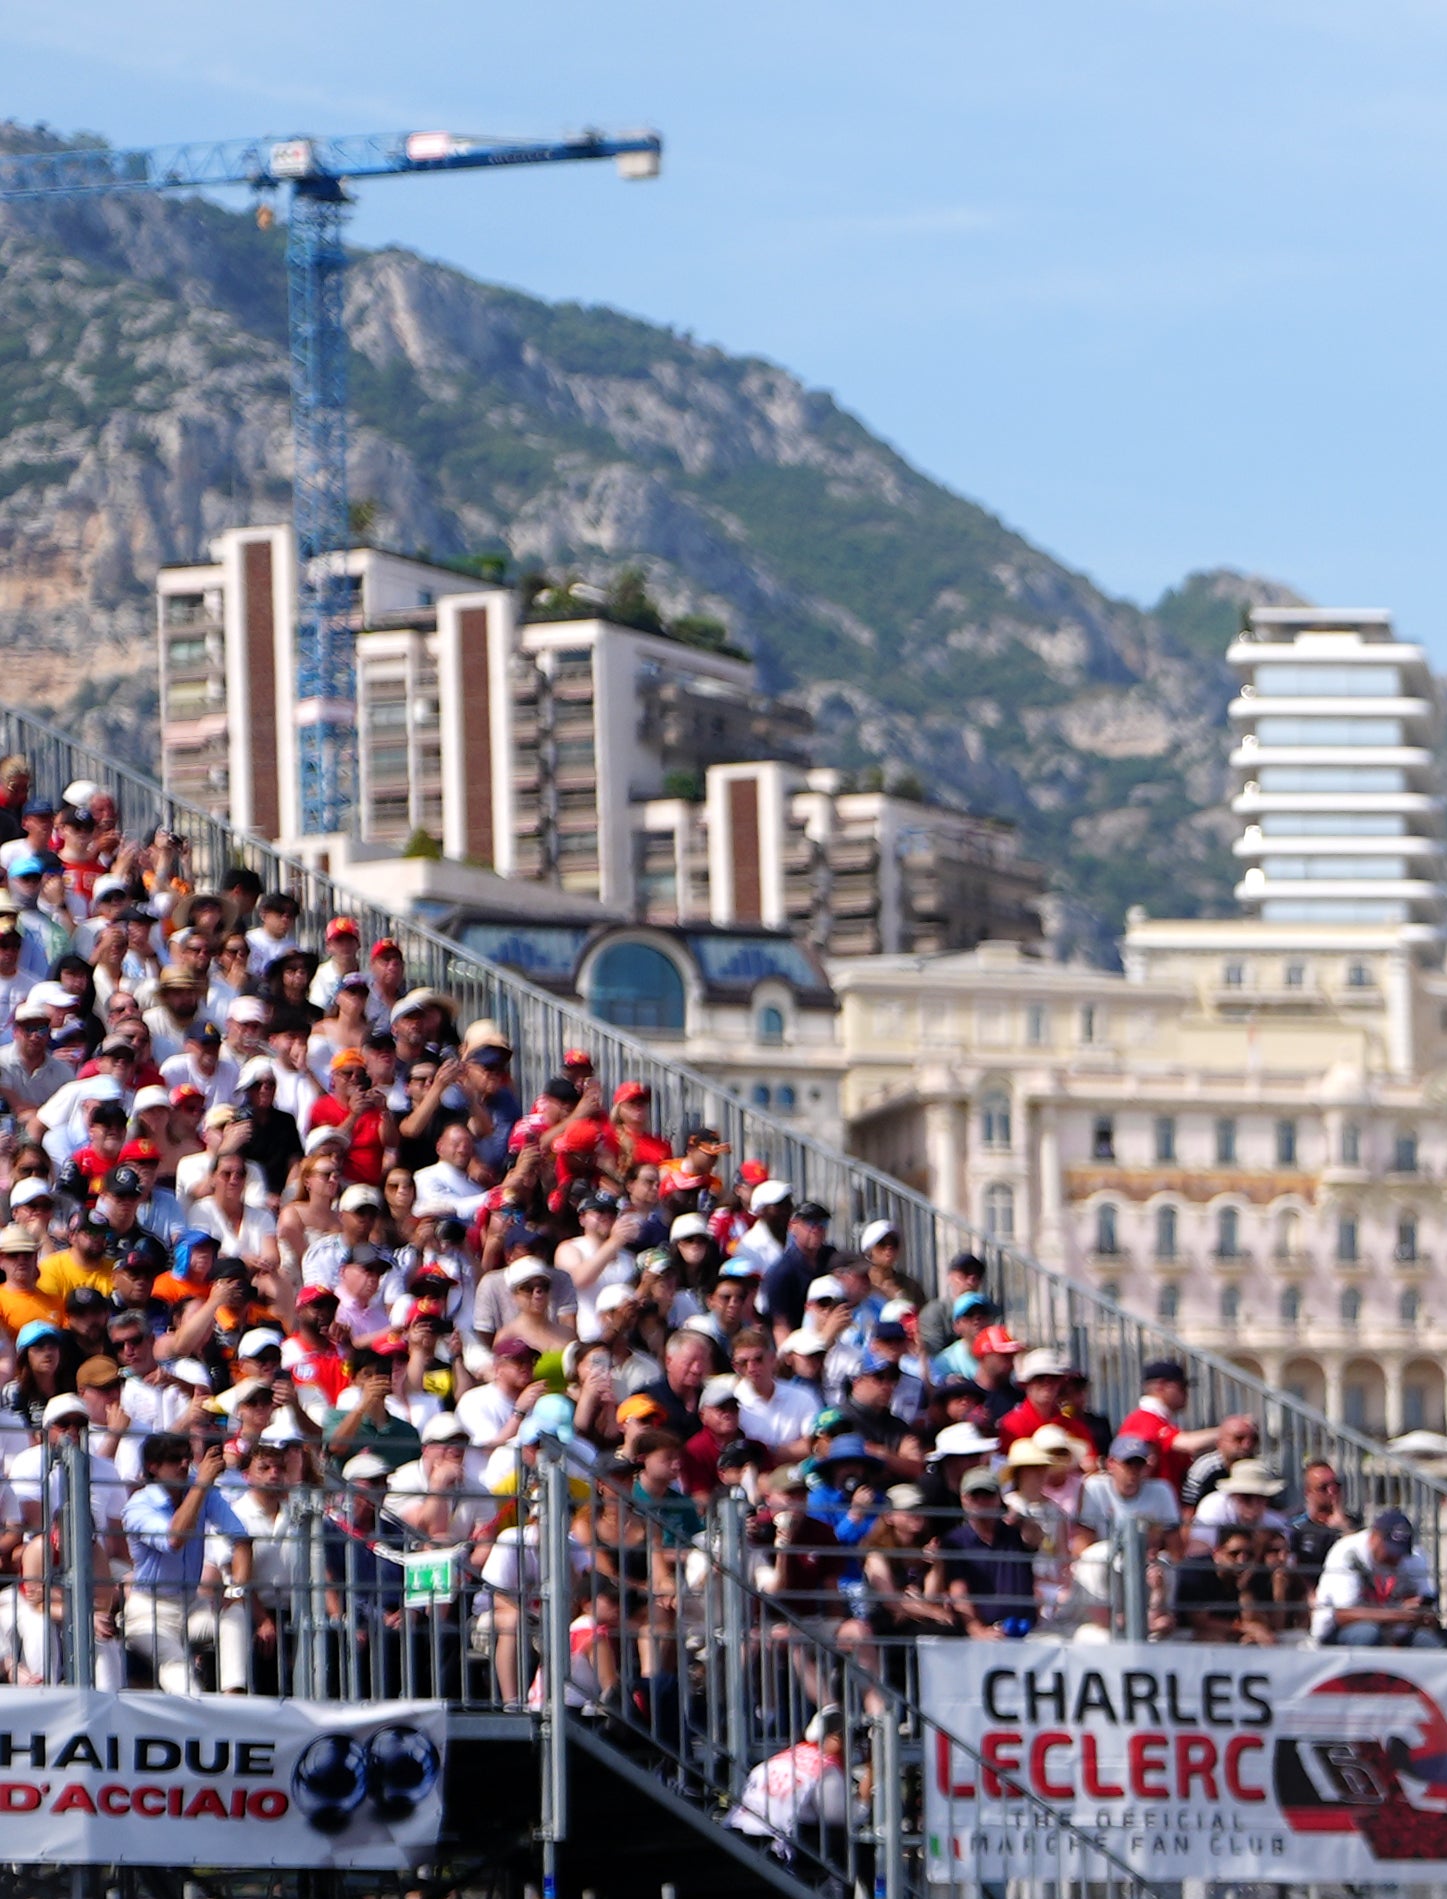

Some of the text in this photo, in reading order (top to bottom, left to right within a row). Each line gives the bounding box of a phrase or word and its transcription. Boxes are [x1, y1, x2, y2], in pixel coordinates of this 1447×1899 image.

[983, 1669, 1275, 1728] CHARLES
[0, 1731, 276, 1778] HAI DUE
[935, 1730, 1268, 1801] LECLERC
[0, 1781, 290, 1821] D'ACCIAIO
[1012, 1810, 1245, 1833] THE OFFICIAL
[1131, 1835, 1190, 1858] FAN
[1211, 1835, 1289, 1858] CLUB
